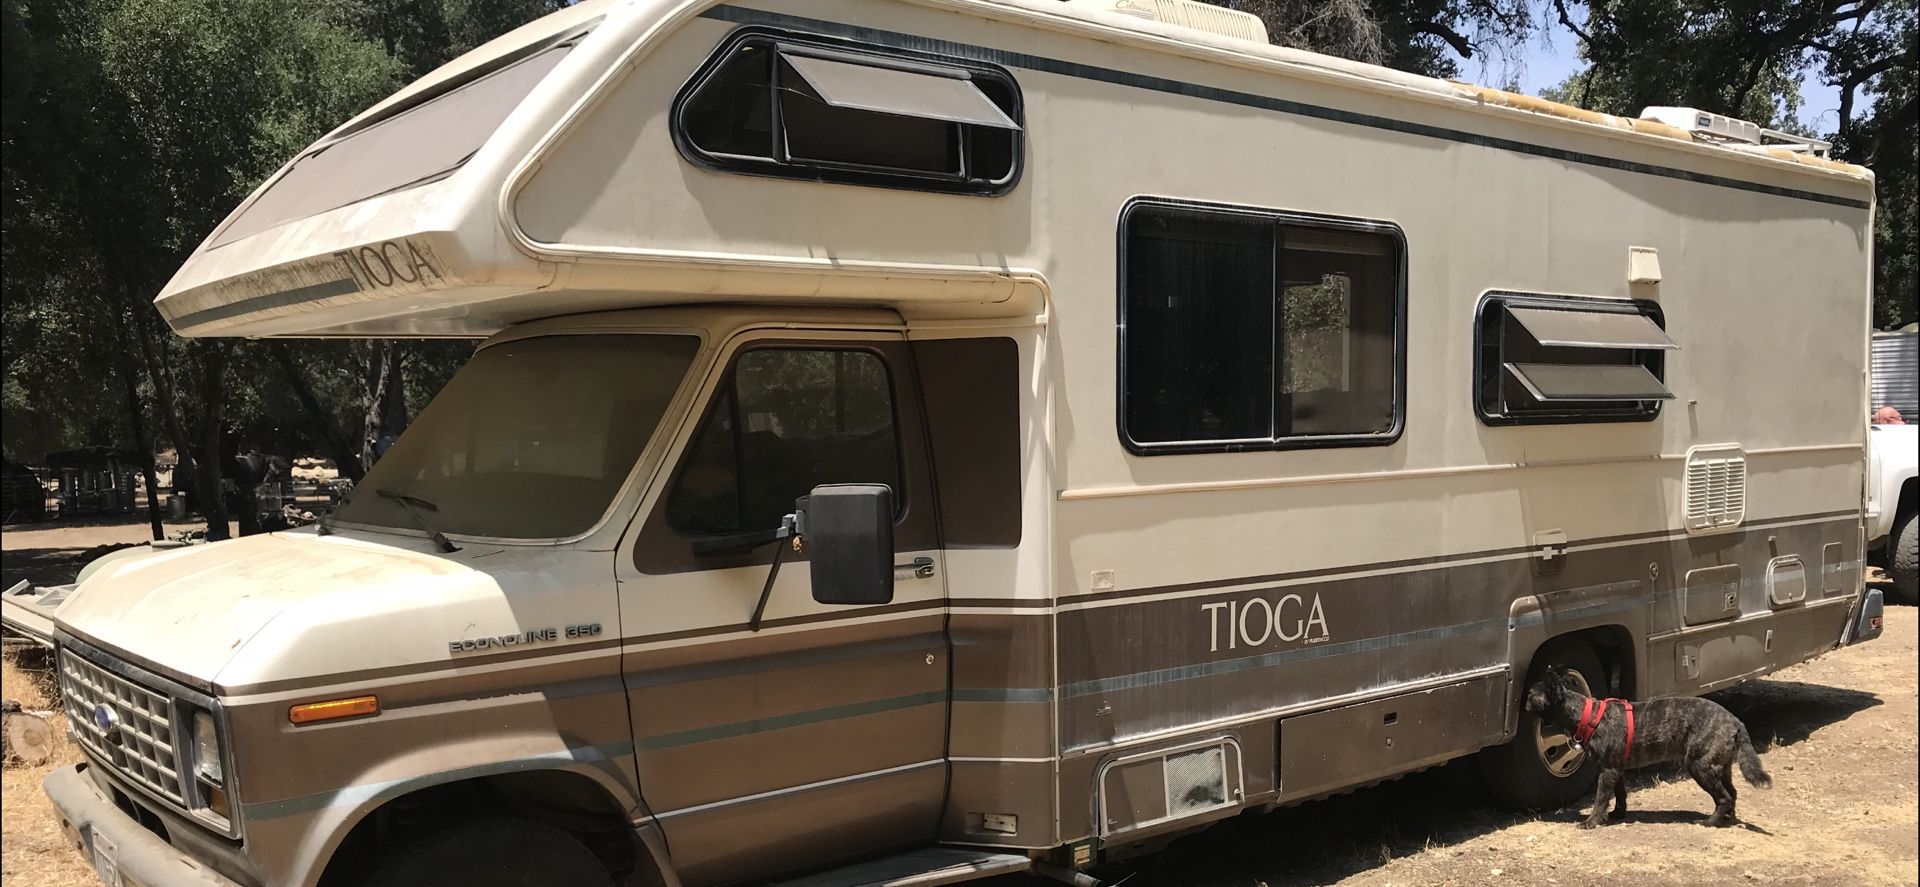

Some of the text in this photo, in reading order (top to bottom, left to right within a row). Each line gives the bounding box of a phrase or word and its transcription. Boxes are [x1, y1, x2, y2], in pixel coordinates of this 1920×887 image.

[334, 238, 442, 290] TIOGA
[448, 624, 603, 653] ECONOLINE 350
[1201, 592, 1330, 652] TIOGA
